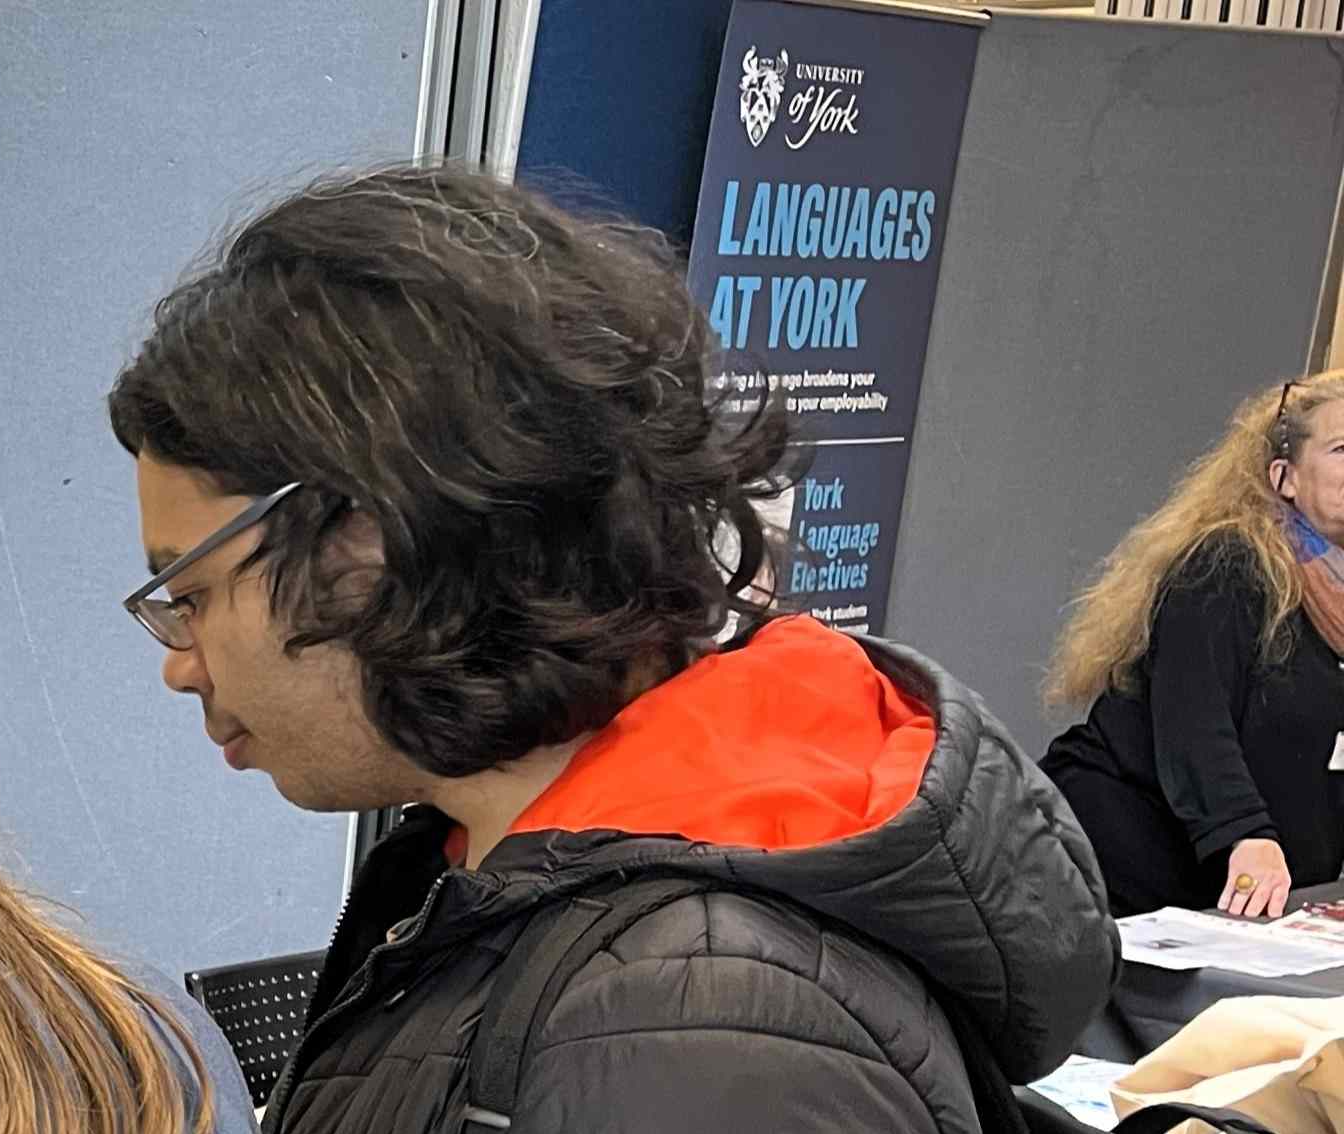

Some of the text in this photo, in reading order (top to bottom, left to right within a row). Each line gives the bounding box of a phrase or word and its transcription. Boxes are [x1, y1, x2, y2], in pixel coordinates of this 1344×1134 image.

[796, 63, 865, 85] UNIVERSITY
[785, 86, 858, 149] of York
[718, 180, 935, 262] LANGUAGES
[710, 275, 867, 350] AT YORK
[803, 369, 848, 387] broadens
[851, 373, 875, 389] your
[798, 398, 819, 413] your
[820, 393, 888, 413] employability
[804, 477, 844, 511] York
[799, 520, 880, 557] Language
[791, 559, 868, 592] Electives
